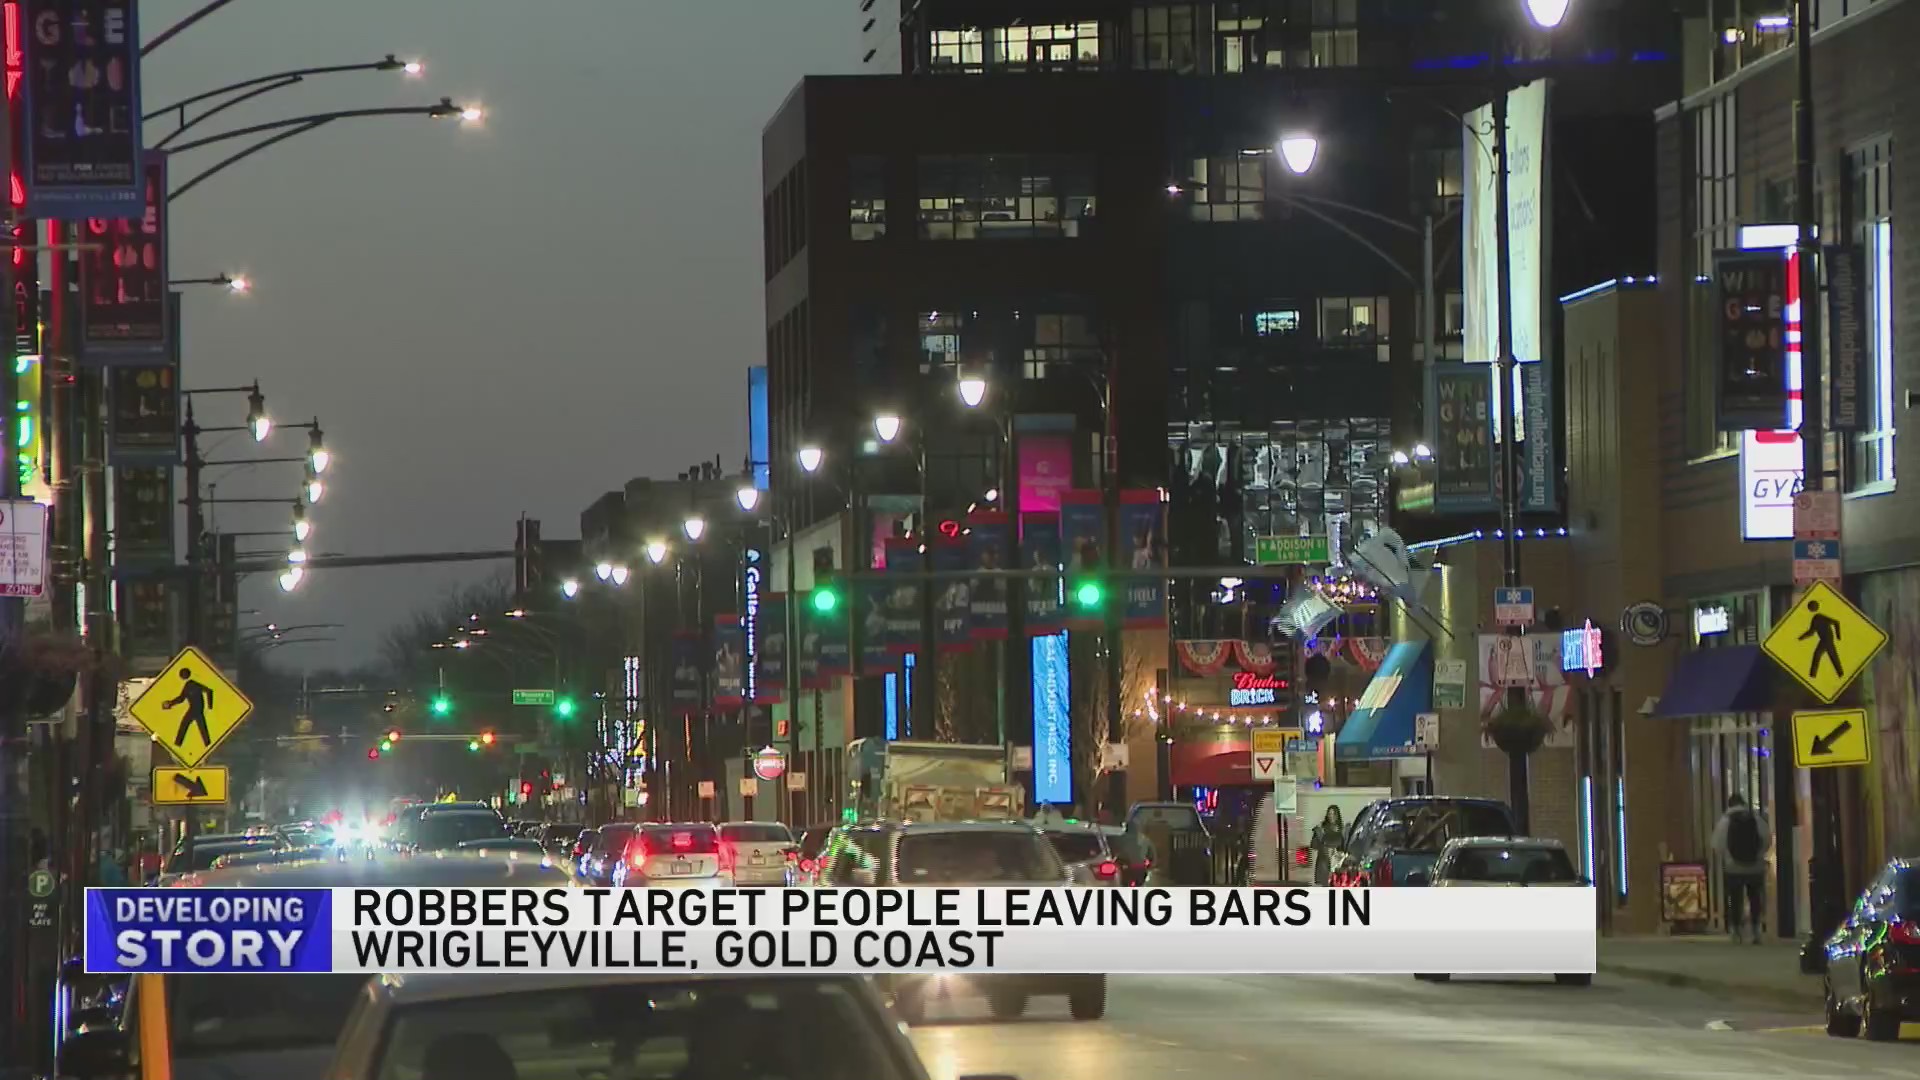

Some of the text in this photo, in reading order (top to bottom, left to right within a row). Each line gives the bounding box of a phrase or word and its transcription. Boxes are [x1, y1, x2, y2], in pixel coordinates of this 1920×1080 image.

[1269, 539, 1314, 551] ADDISON
[6, 584, 37, 595] ZONE
[1048, 758, 1059, 787] INC.
